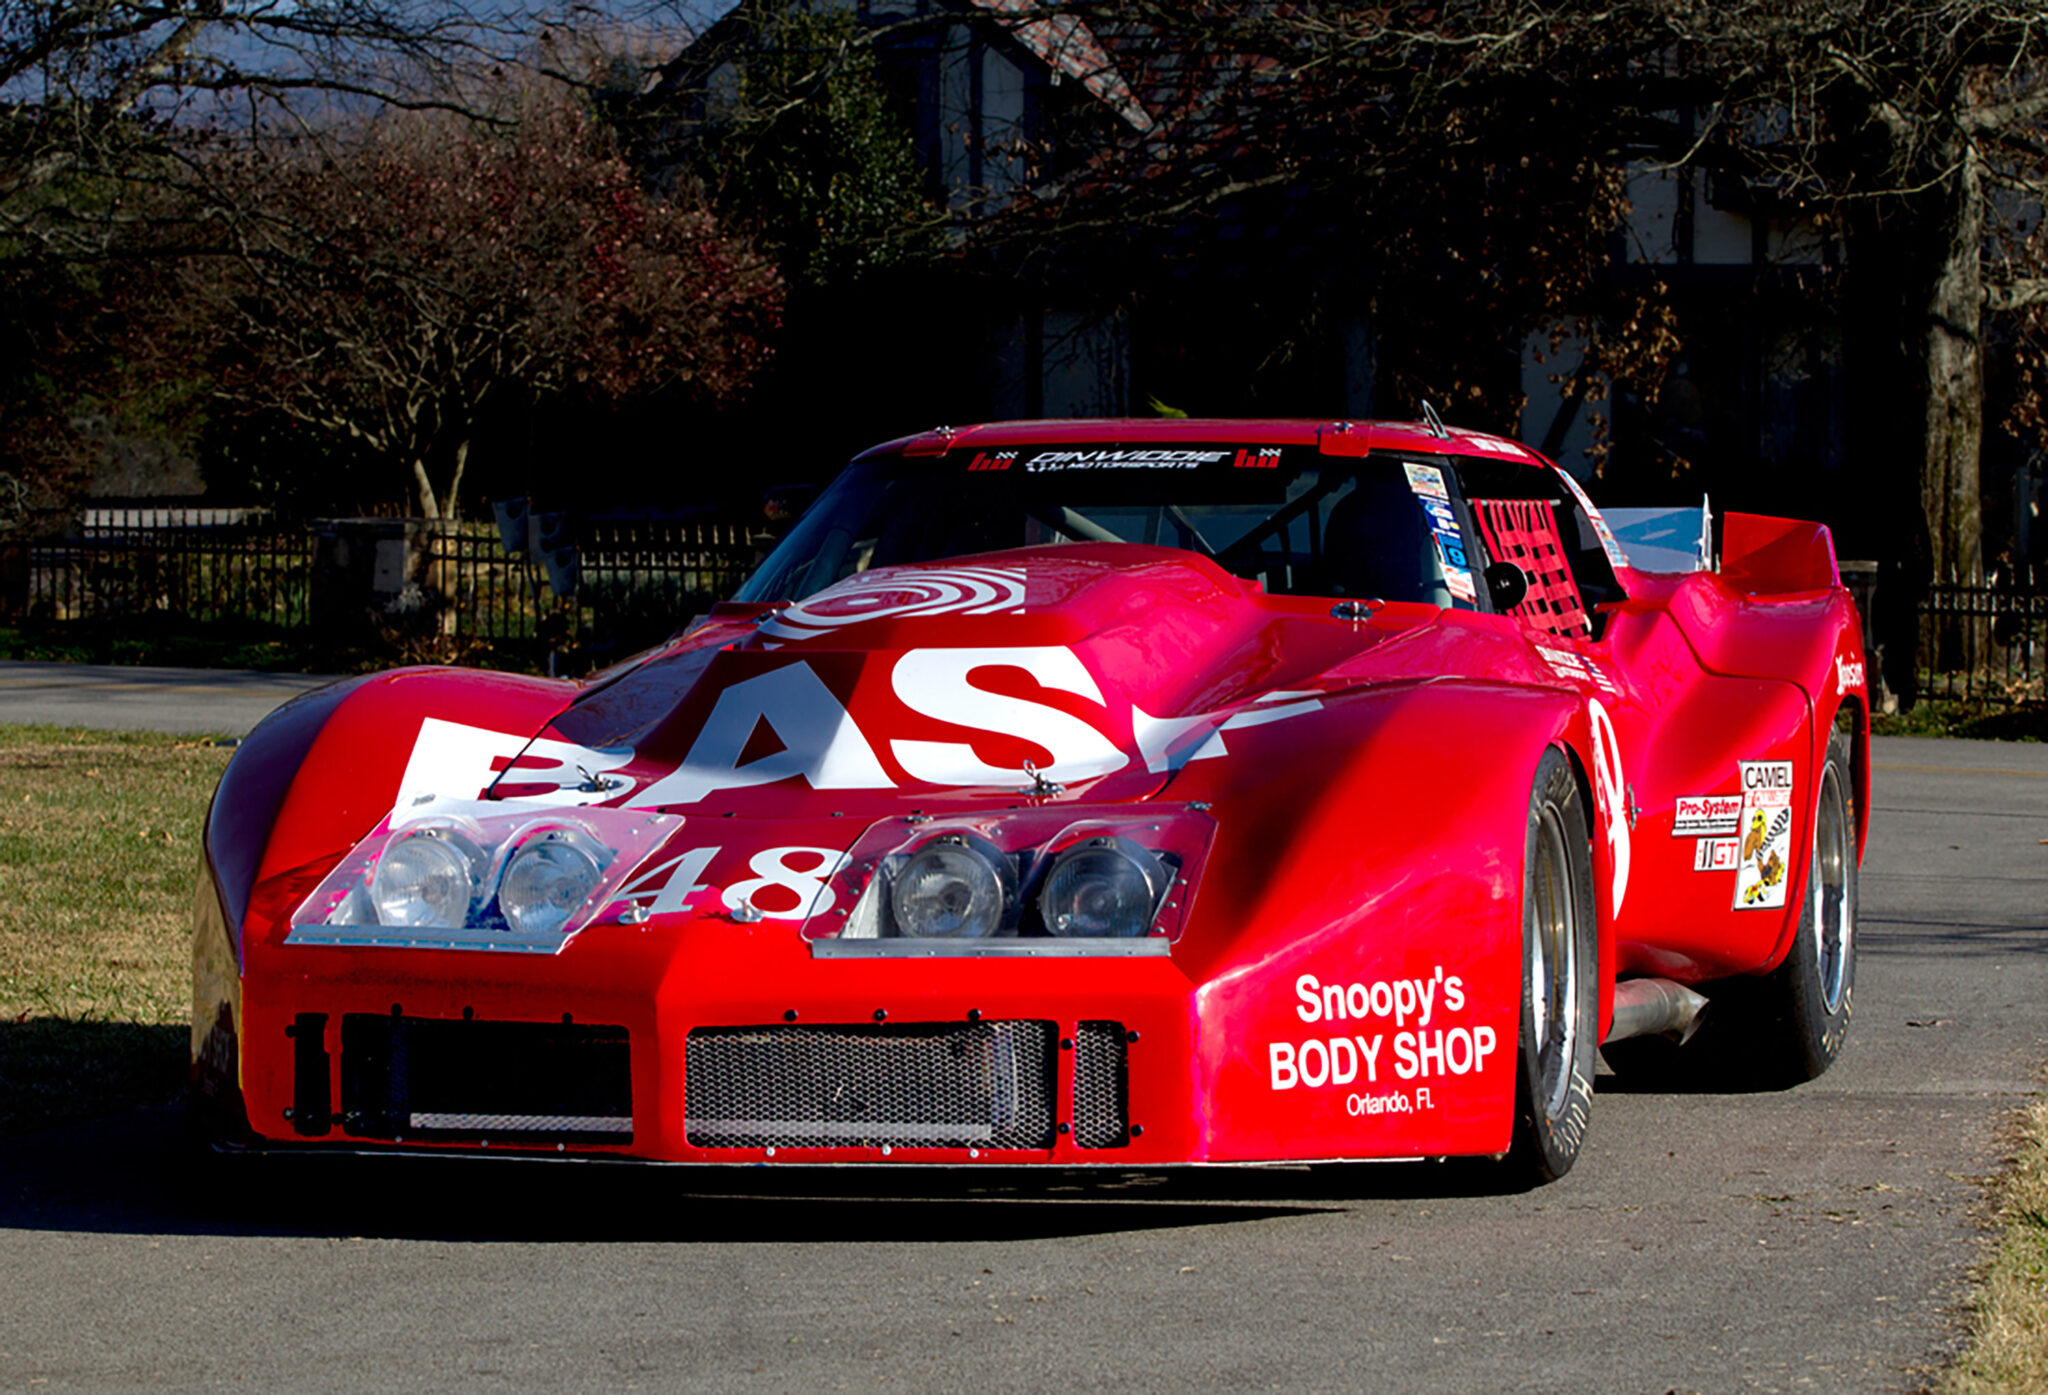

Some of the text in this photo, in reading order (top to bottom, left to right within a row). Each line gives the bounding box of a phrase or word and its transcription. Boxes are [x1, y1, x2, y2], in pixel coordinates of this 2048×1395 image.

[1745, 767, 1791, 789] CAMEL
[1679, 799, 1739, 818] Pro-System
[606, 846, 853, 920] 48
[1295, 965, 1466, 1027] Snoopy's
[1269, 1026, 1497, 1090] BODY SHOP
[1346, 1090, 1414, 1117] Orlando,
